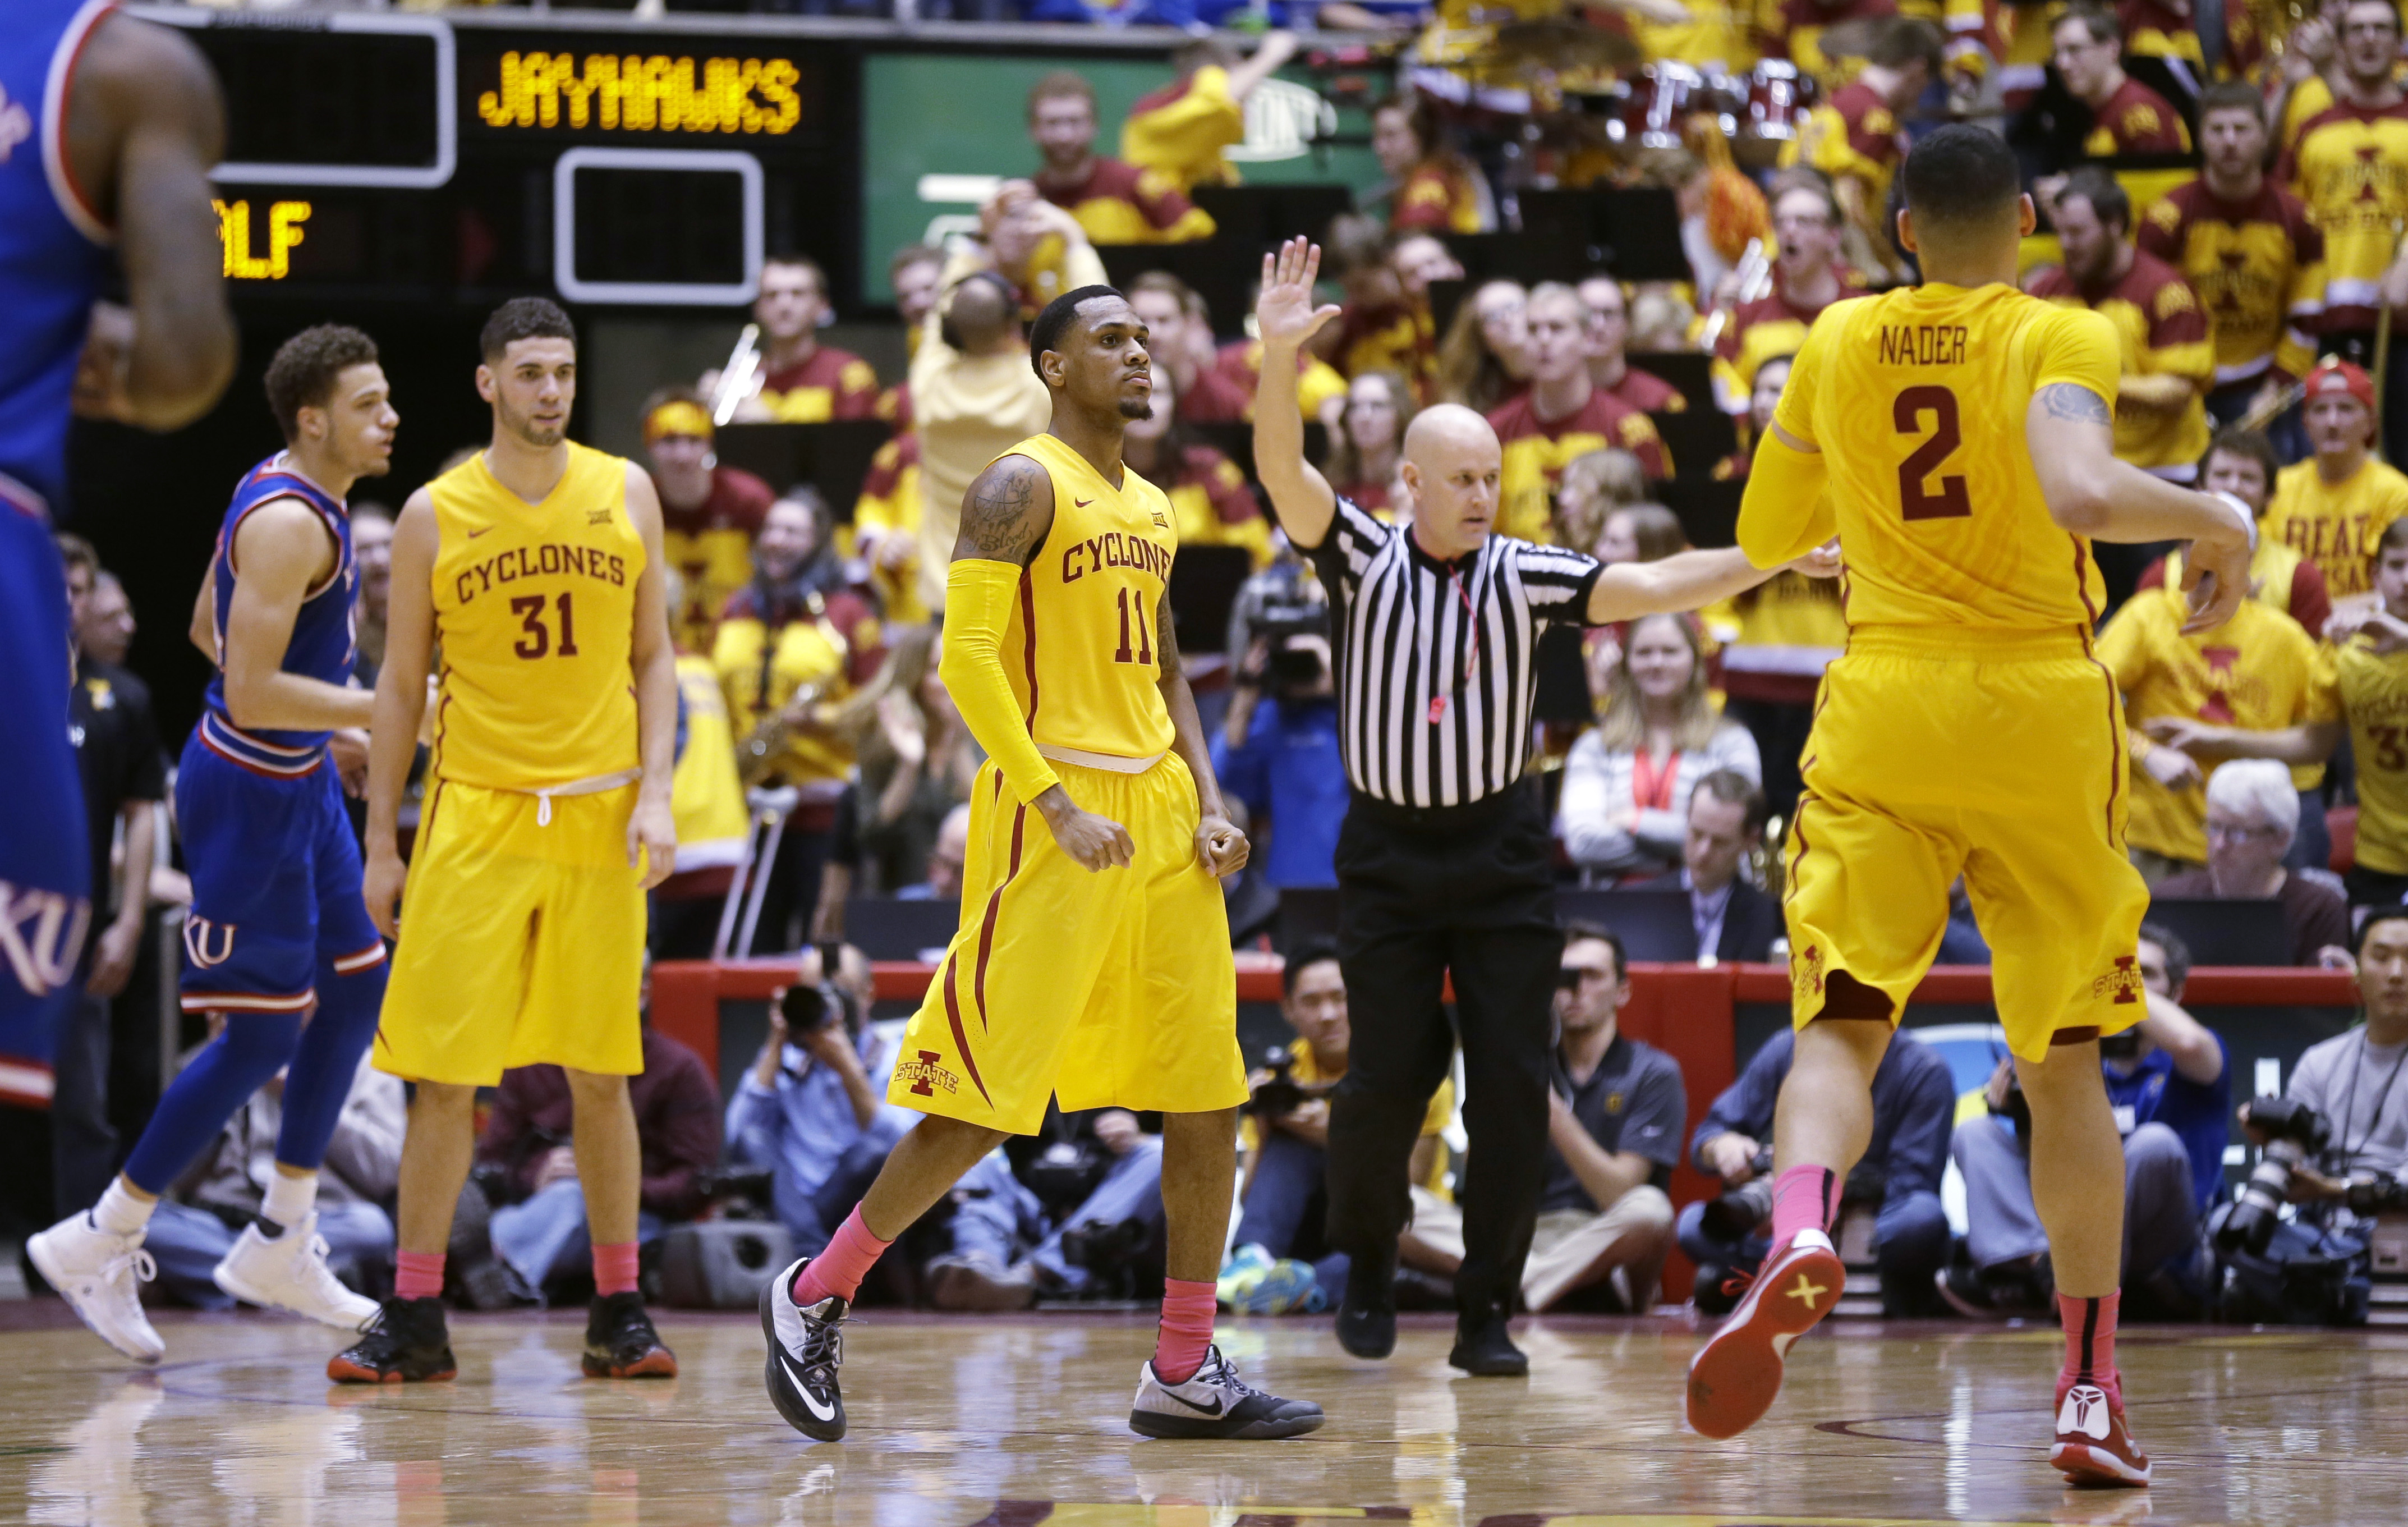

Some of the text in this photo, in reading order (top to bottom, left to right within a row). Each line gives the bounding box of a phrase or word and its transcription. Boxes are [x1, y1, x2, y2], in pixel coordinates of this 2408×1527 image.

[478, 50, 801, 134] JAYHAWKS
[1879, 324, 1968, 365] NADER
[1893, 384, 1973, 521] 2
[1062, 532, 1171, 584] CYCLONE
[2285, 512, 2371, 559] BEAT
[457, 544, 624, 605] CYCLONES
[510, 591, 578, 660] 31
[1114, 586, 1152, 665] 11
[182, 909, 238, 970] KU
[894, 1062, 959, 1095] STATE
